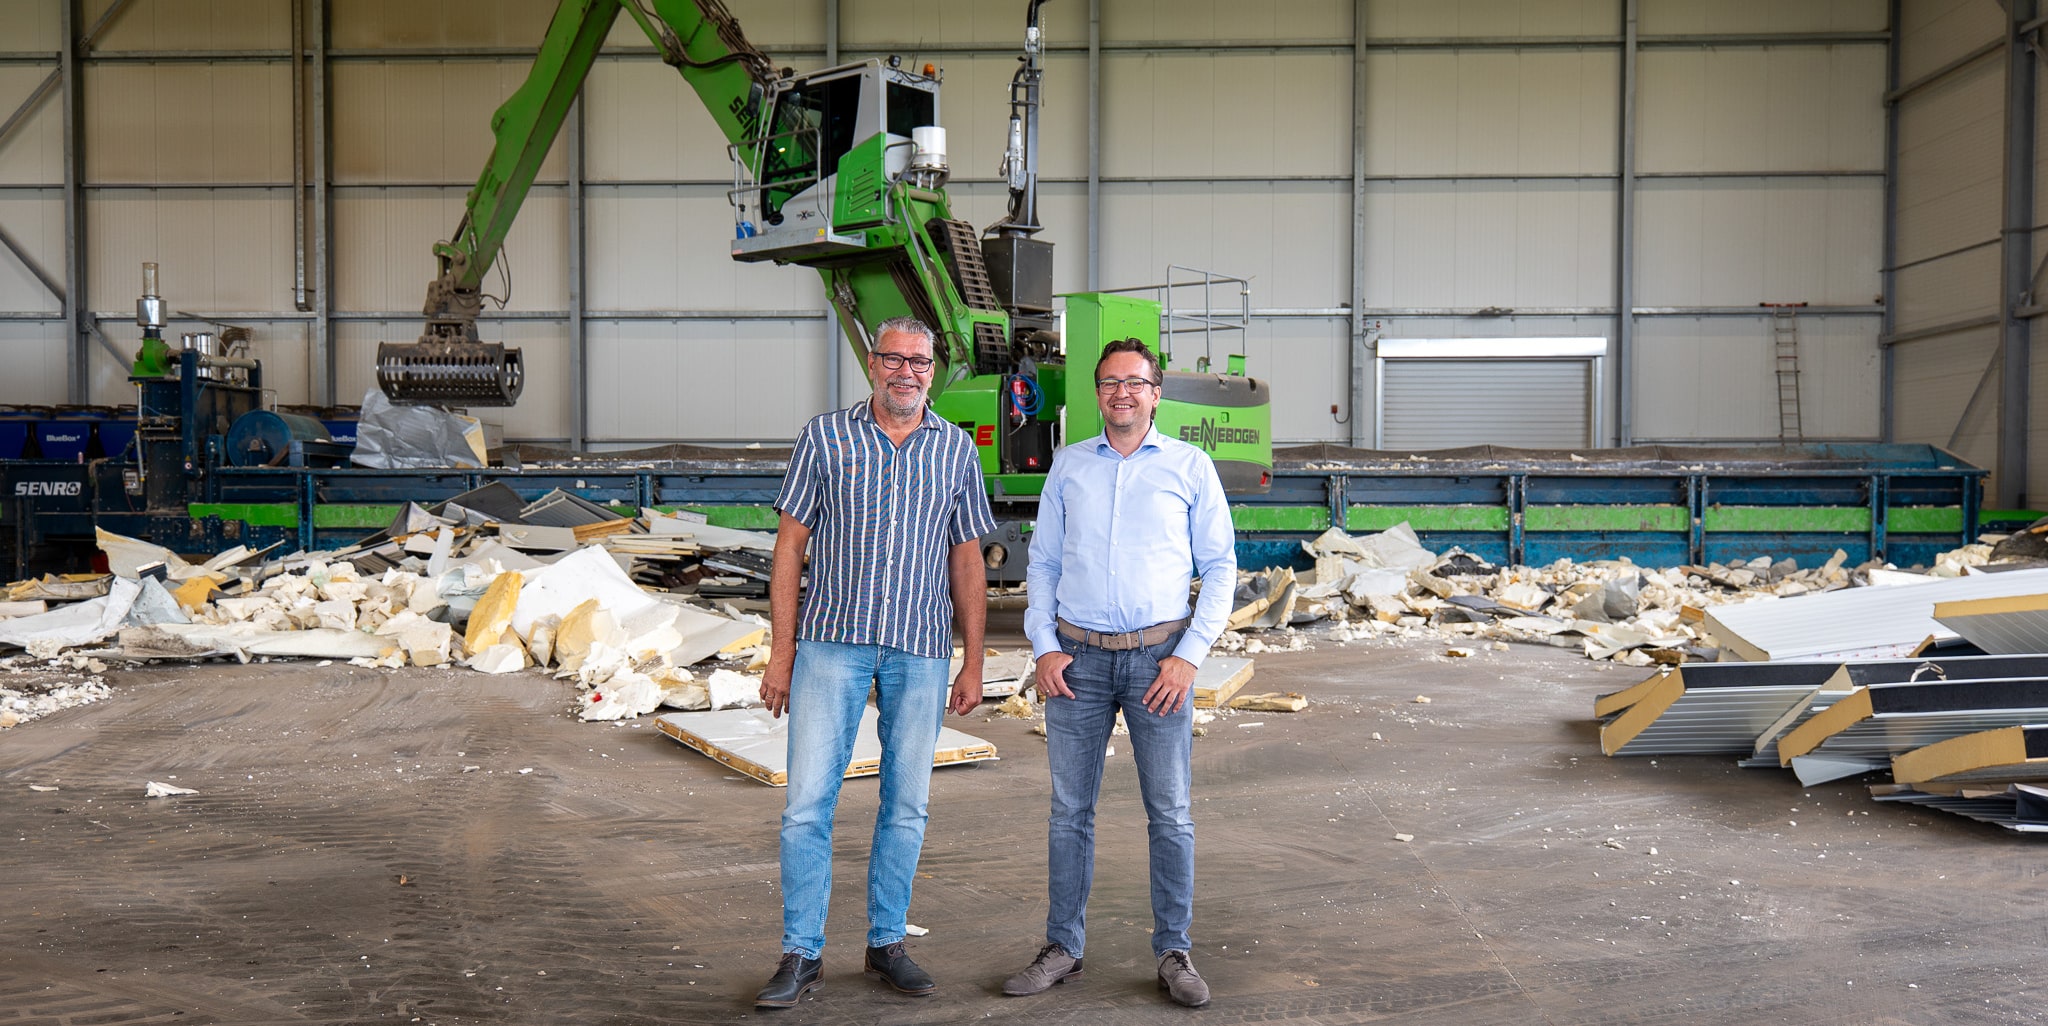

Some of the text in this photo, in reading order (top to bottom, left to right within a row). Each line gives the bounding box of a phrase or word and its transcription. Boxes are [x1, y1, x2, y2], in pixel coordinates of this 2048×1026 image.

[46, 434, 77, 442] BlueBox
[1179, 417, 1260, 451] SENNEBOGEN
[15, 482, 81, 496] SENRO
